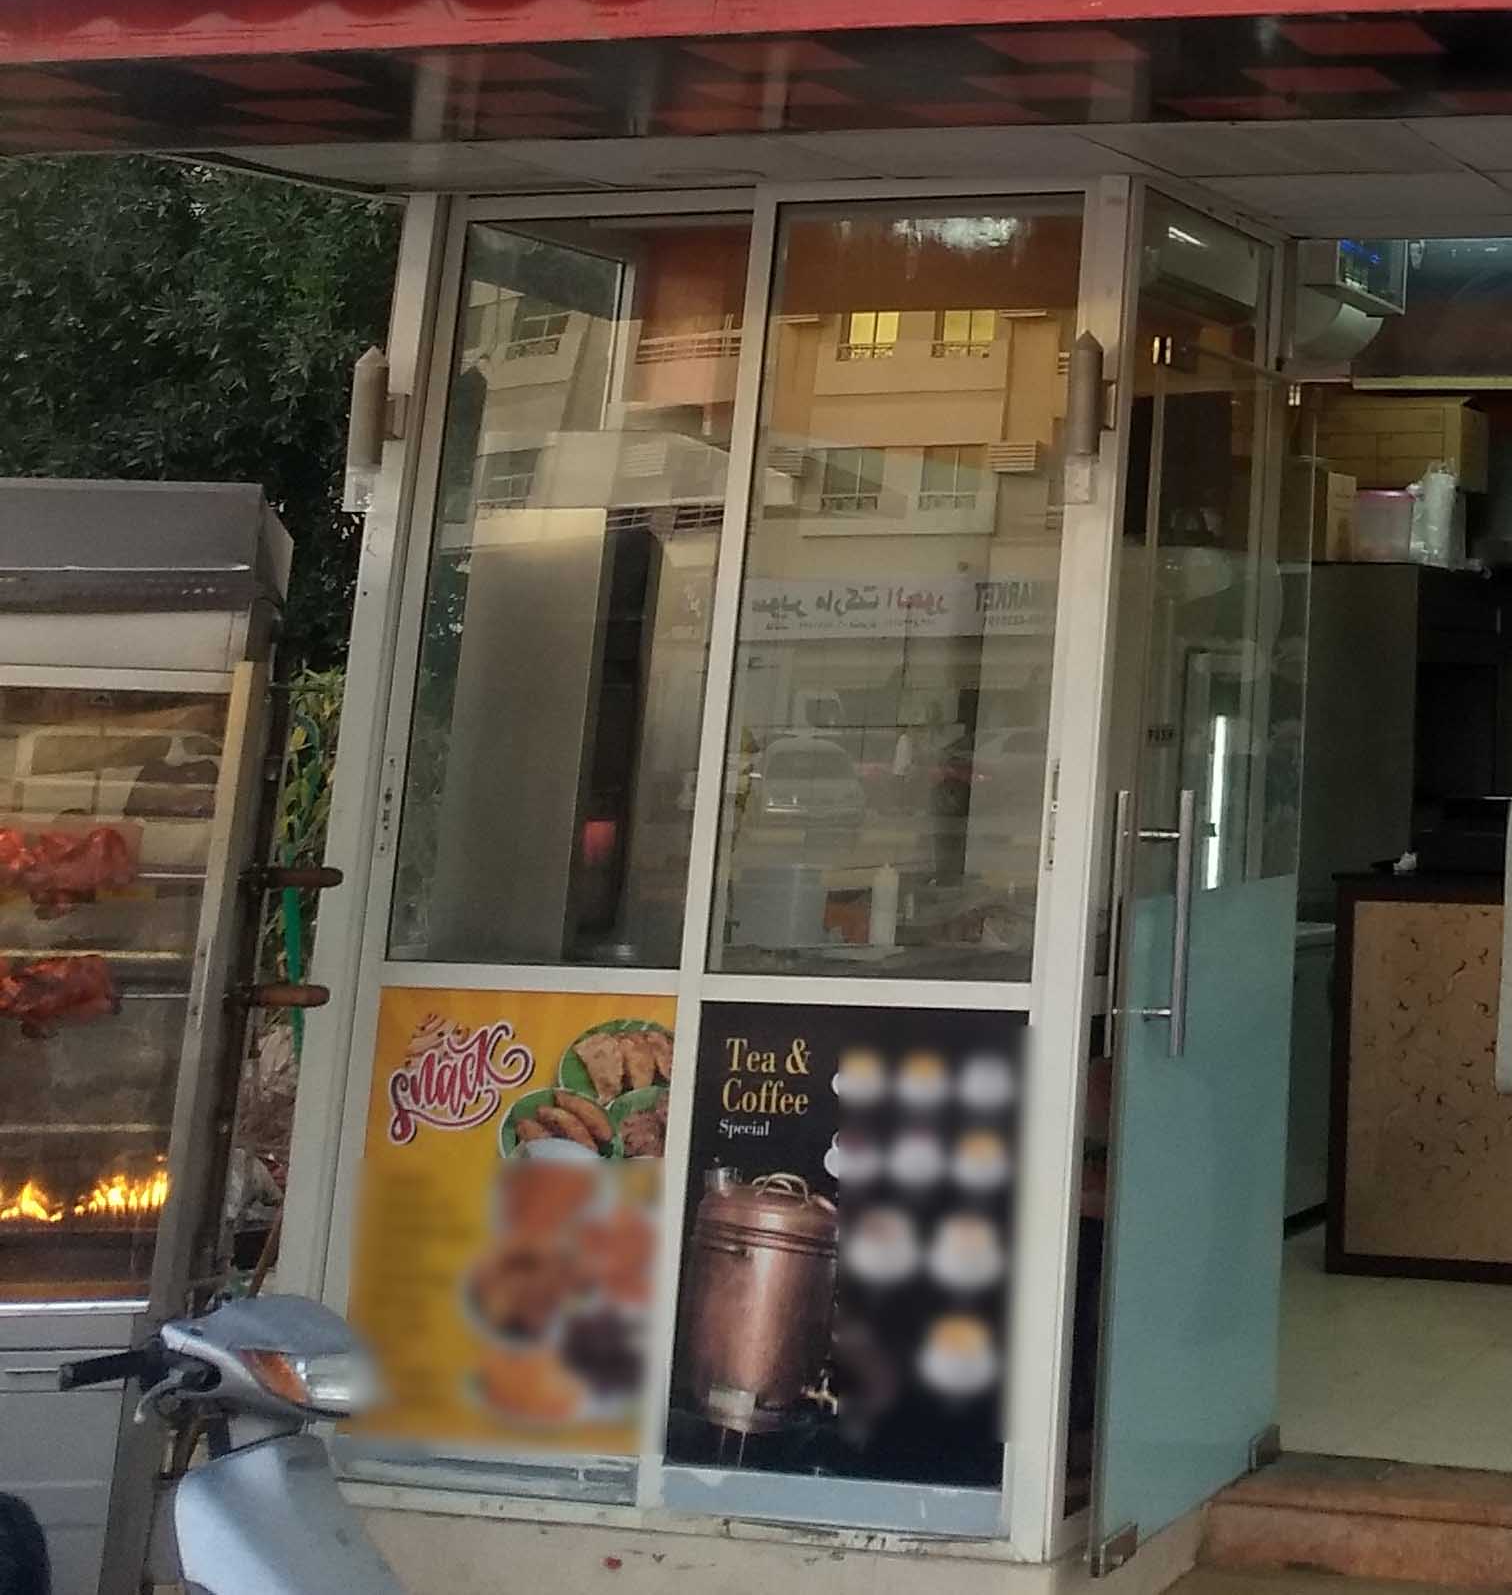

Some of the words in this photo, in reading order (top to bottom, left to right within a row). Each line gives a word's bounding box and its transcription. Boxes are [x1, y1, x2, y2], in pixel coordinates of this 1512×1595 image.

[725, 1037, 777, 1074] Tea
[785, 1037, 812, 1075] &
[722, 1077, 809, 1115] Coffee
[718, 1117, 770, 1139] Special
